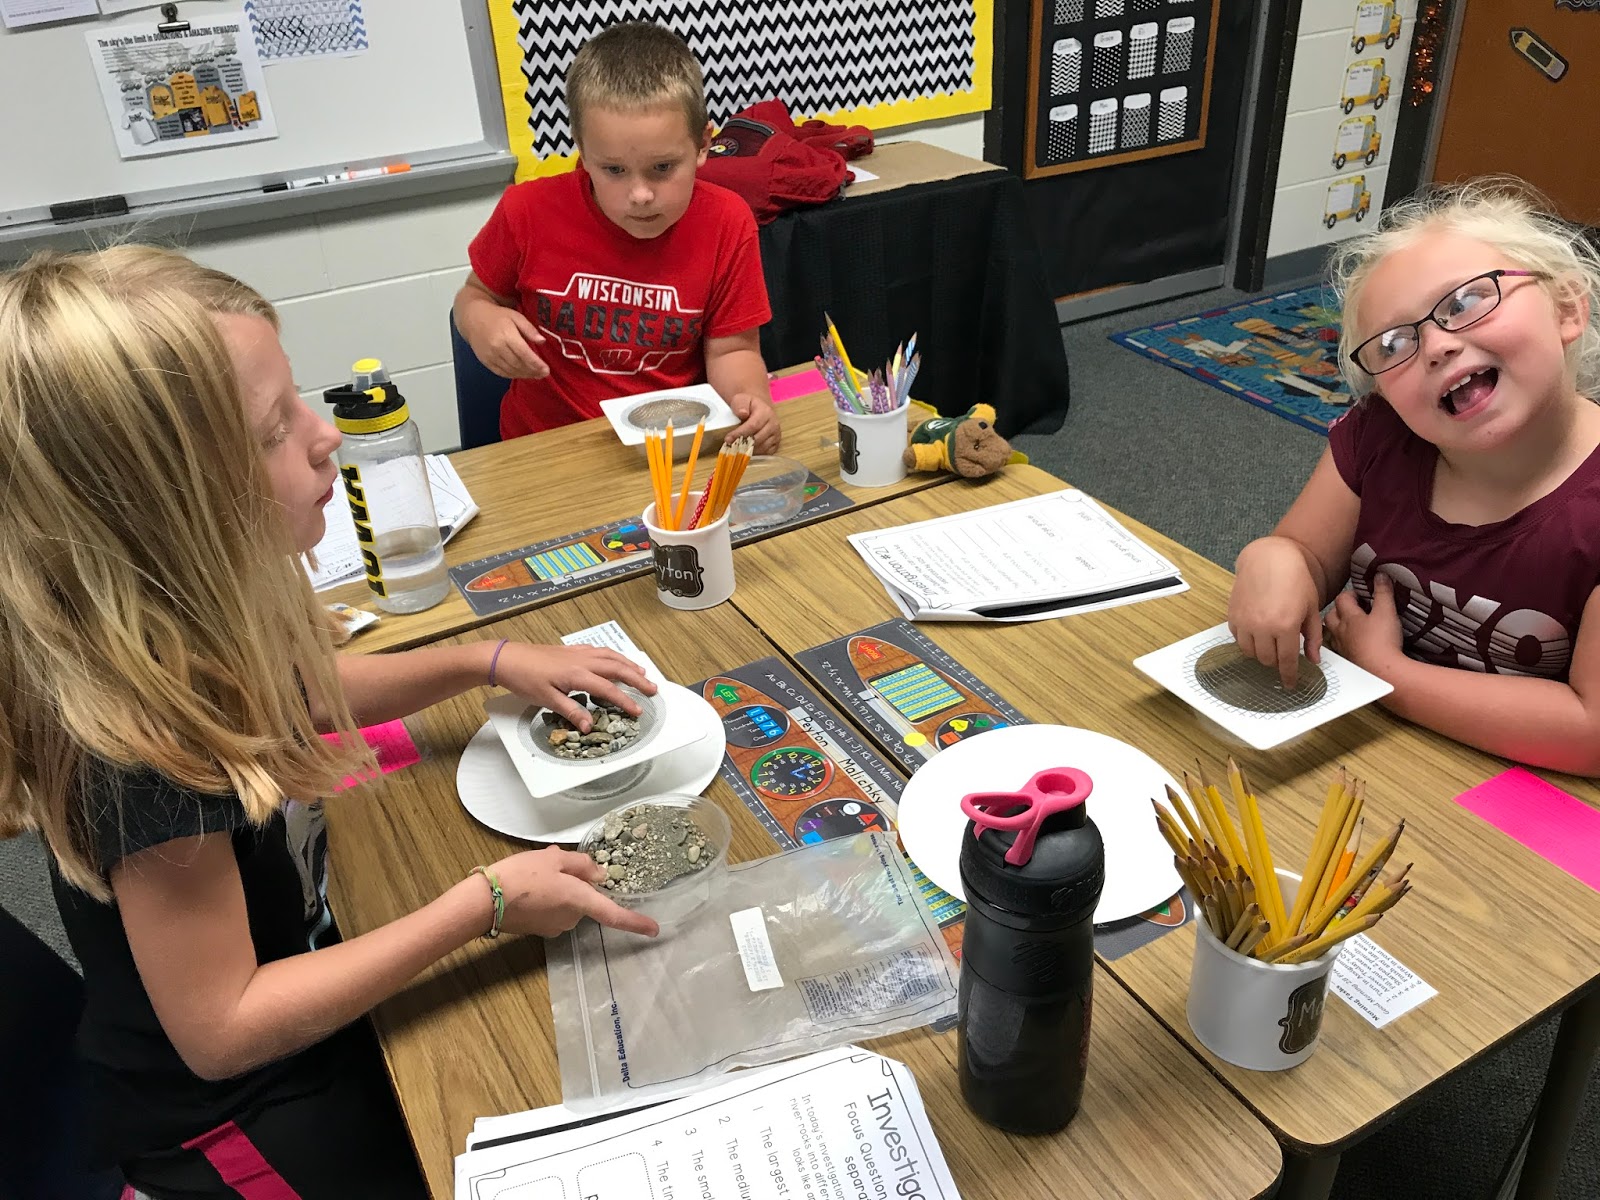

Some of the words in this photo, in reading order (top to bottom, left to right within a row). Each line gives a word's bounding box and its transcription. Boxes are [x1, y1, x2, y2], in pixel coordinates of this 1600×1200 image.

[189, 27, 212, 37] AMAZING
[578, 278, 672, 311] WISCONSIN
[536, 295, 702, 348] BADGERS
[872, 545, 892, 561] #21
[889, 559, 939, 596] Investigation
[861, 645, 881, 659] RIGHT
[720, 688, 737, 702] LEFT
[797, 716, 829, 748] Peyton
[938, 907, 963, 922] RID
[1355, 957, 1371, 969] water
[1367, 950, 1378, 959] late
[1379, 958, 1389, 967] any
[1377, 966, 1402, 985] Sharpen
[1389, 967, 1407, 982] Finish
[1396, 965, 1413, 978] Write
[1335, 985, 1353, 999] Tasks
[1367, 975, 1389, 992] Answer
[1368, 984, 1383, 996] Turn
[1385, 980, 1395, 988] Fill
[1352, 999, 1380, 1020] Morning
[614, 1016, 626, 1060] Education,
[621, 1062, 630, 1083] Delta
[802, 1094, 811, 1105] In
[806, 1106, 823, 1141] today's
[844, 1101, 864, 1140] Focus
[790, 1098, 802, 1121] river
[799, 1123, 812, 1150] rocks
[807, 1151, 819, 1170] into
[726, 1138, 738, 1161] The
[692, 1149, 703, 1172] The
[759, 1126, 773, 1150] The
[767, 1151, 789, 1196] largest
[792, 1148, 806, 1173] looks
[802, 1174, 812, 1191] like
[656, 1160, 669, 1183] The
[844, 1156, 871, 1200] separa
